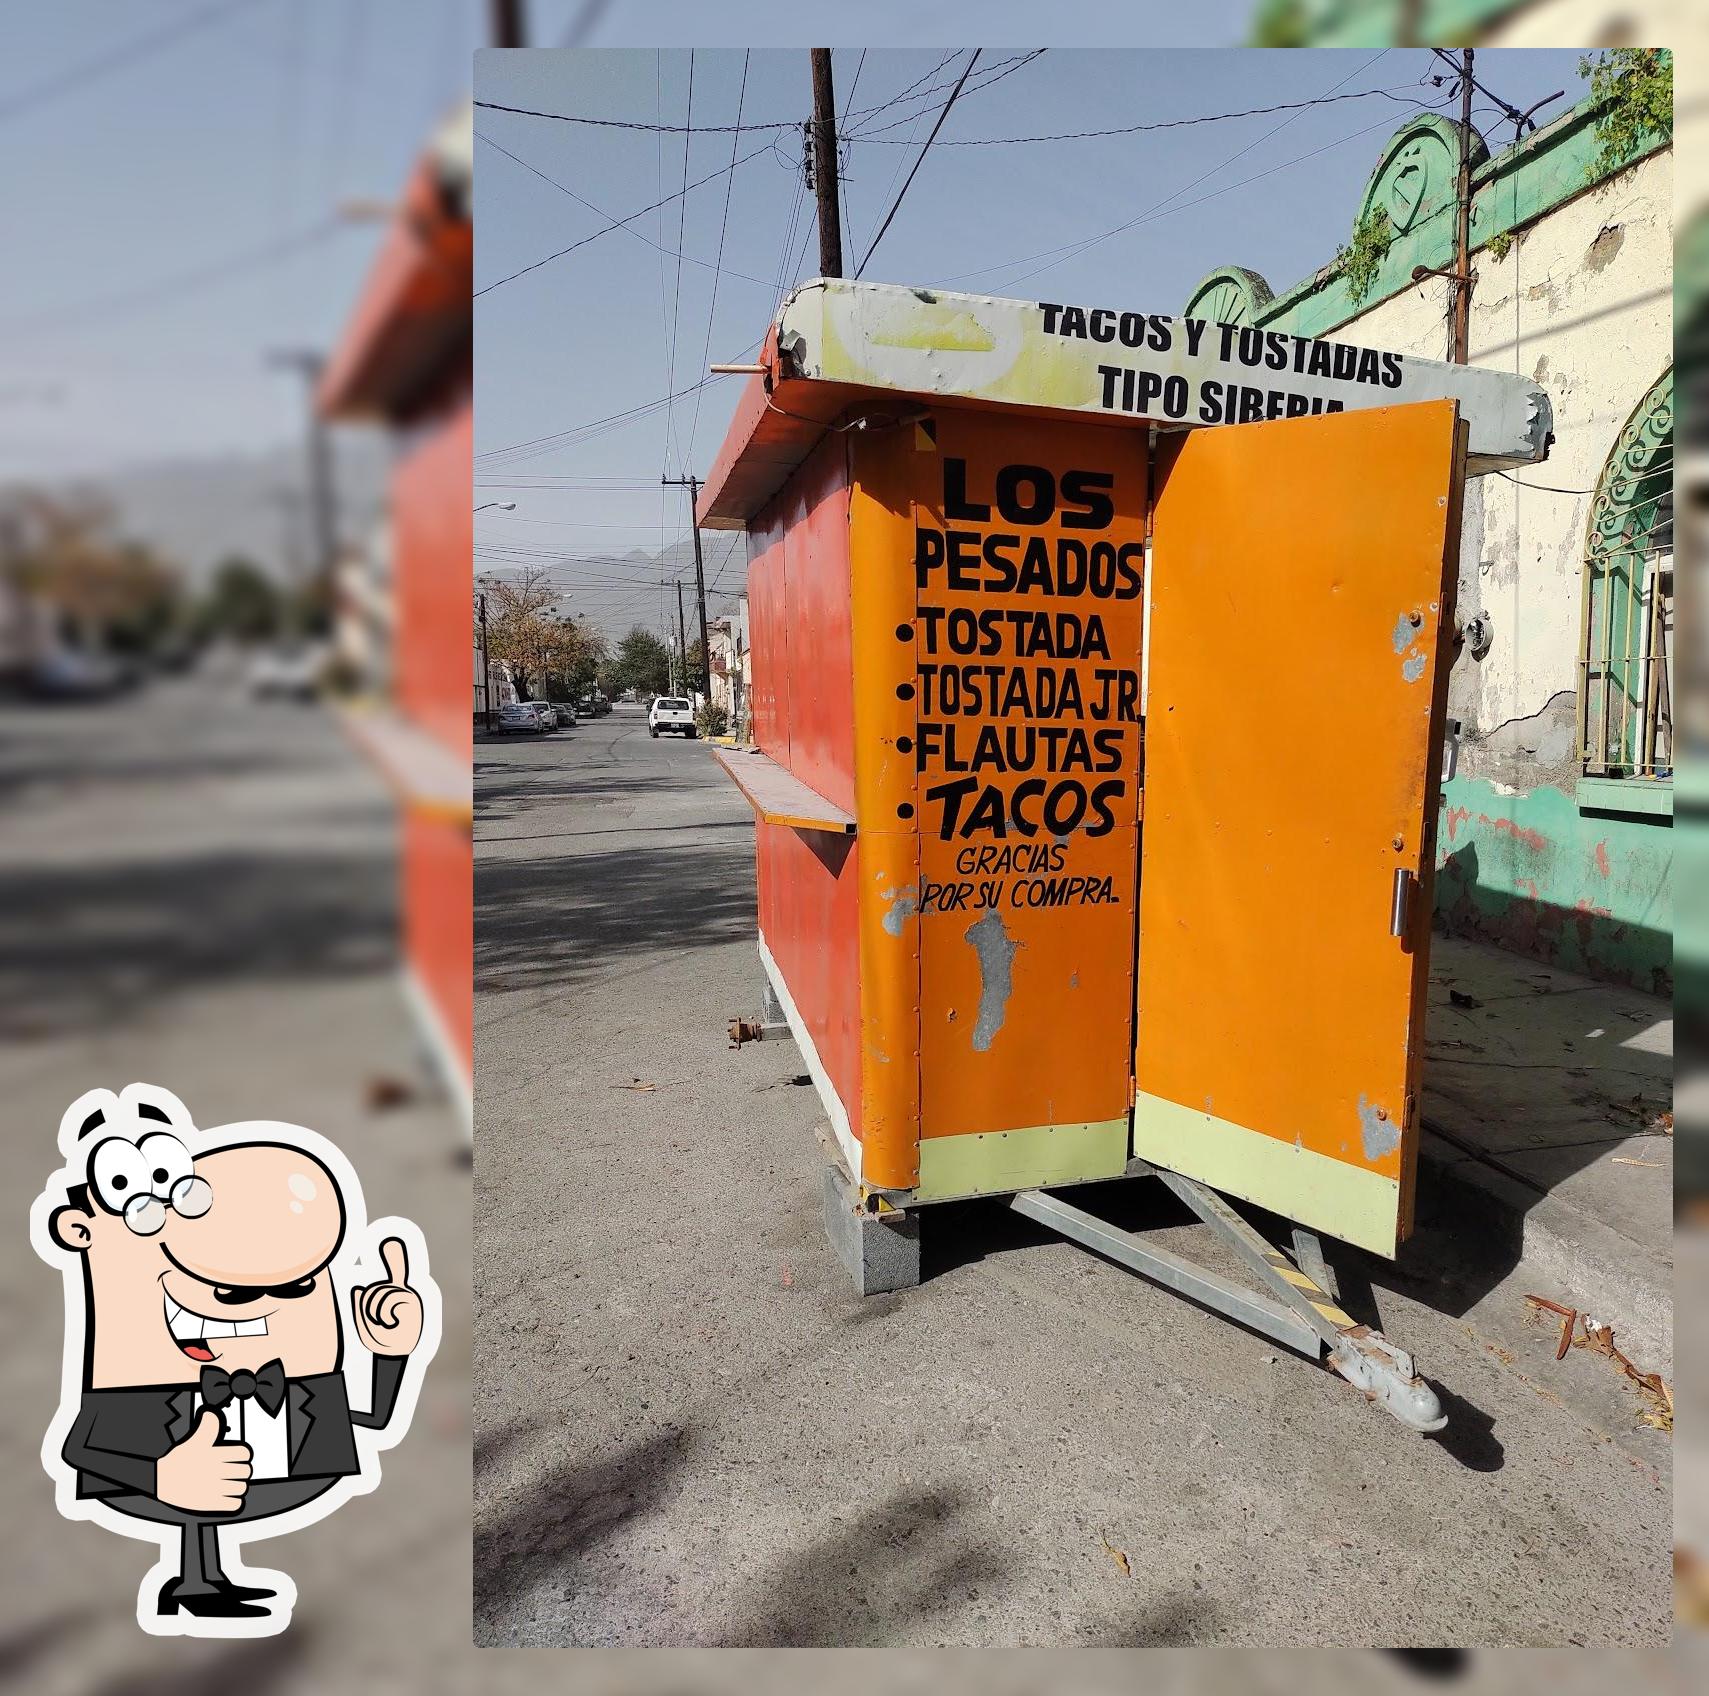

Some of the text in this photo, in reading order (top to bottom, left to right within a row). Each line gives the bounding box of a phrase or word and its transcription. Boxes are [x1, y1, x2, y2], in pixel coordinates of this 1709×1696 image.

[1039, 302, 1403, 389] TACOS Y TOSTADAS
[1098, 365, 1189, 419] TIPO
[944, 457, 1114, 530] LOS
[916, 528, 1143, 600] PESADOS
[917, 607, 1111, 660] TOSTADA
[917, 664, 1139, 722] TOSTADA JR
[917, 723, 1124, 773] FLAUTAS
[926, 776, 1125, 841] TACOS
[956, 844, 1068, 875] GRACIAS
[920, 882, 974, 913] POR
[974, 880, 1004, 909] SU
